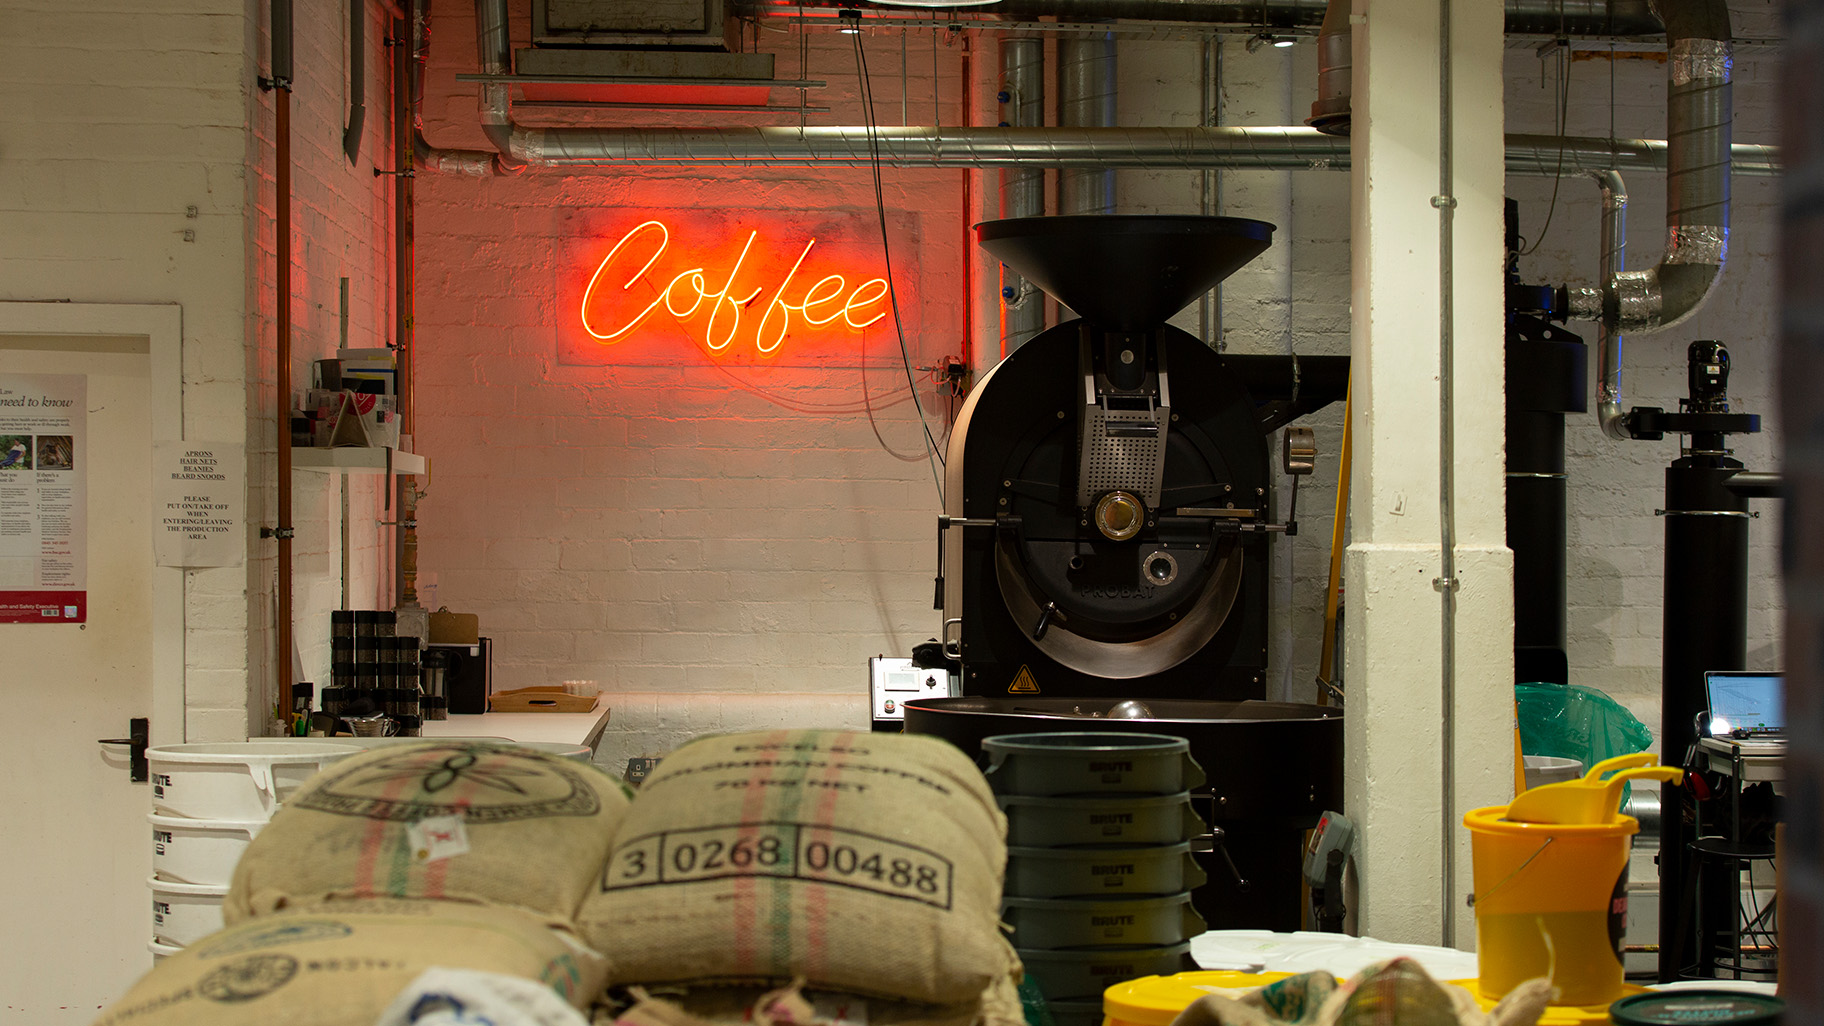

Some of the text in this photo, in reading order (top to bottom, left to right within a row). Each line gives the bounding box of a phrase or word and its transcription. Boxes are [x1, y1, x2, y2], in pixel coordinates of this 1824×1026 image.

[581, 220, 888, 353] Coffee
[0, 396, 73, 407] need to know
[1080, 584, 1154, 599] PROBAT
[1089, 762, 1132, 772] BRUTE
[836, 762, 951, 795] COFFEE
[809, 779, 871, 793] NET
[1090, 813, 1133, 824] BRUTE
[621, 835, 939, 895] 3 0268 00488
[1091, 864, 1135, 876] BRUTE
[1091, 915, 1135, 926] BRUTE
[1090, 965, 1134, 976] BRUTE
